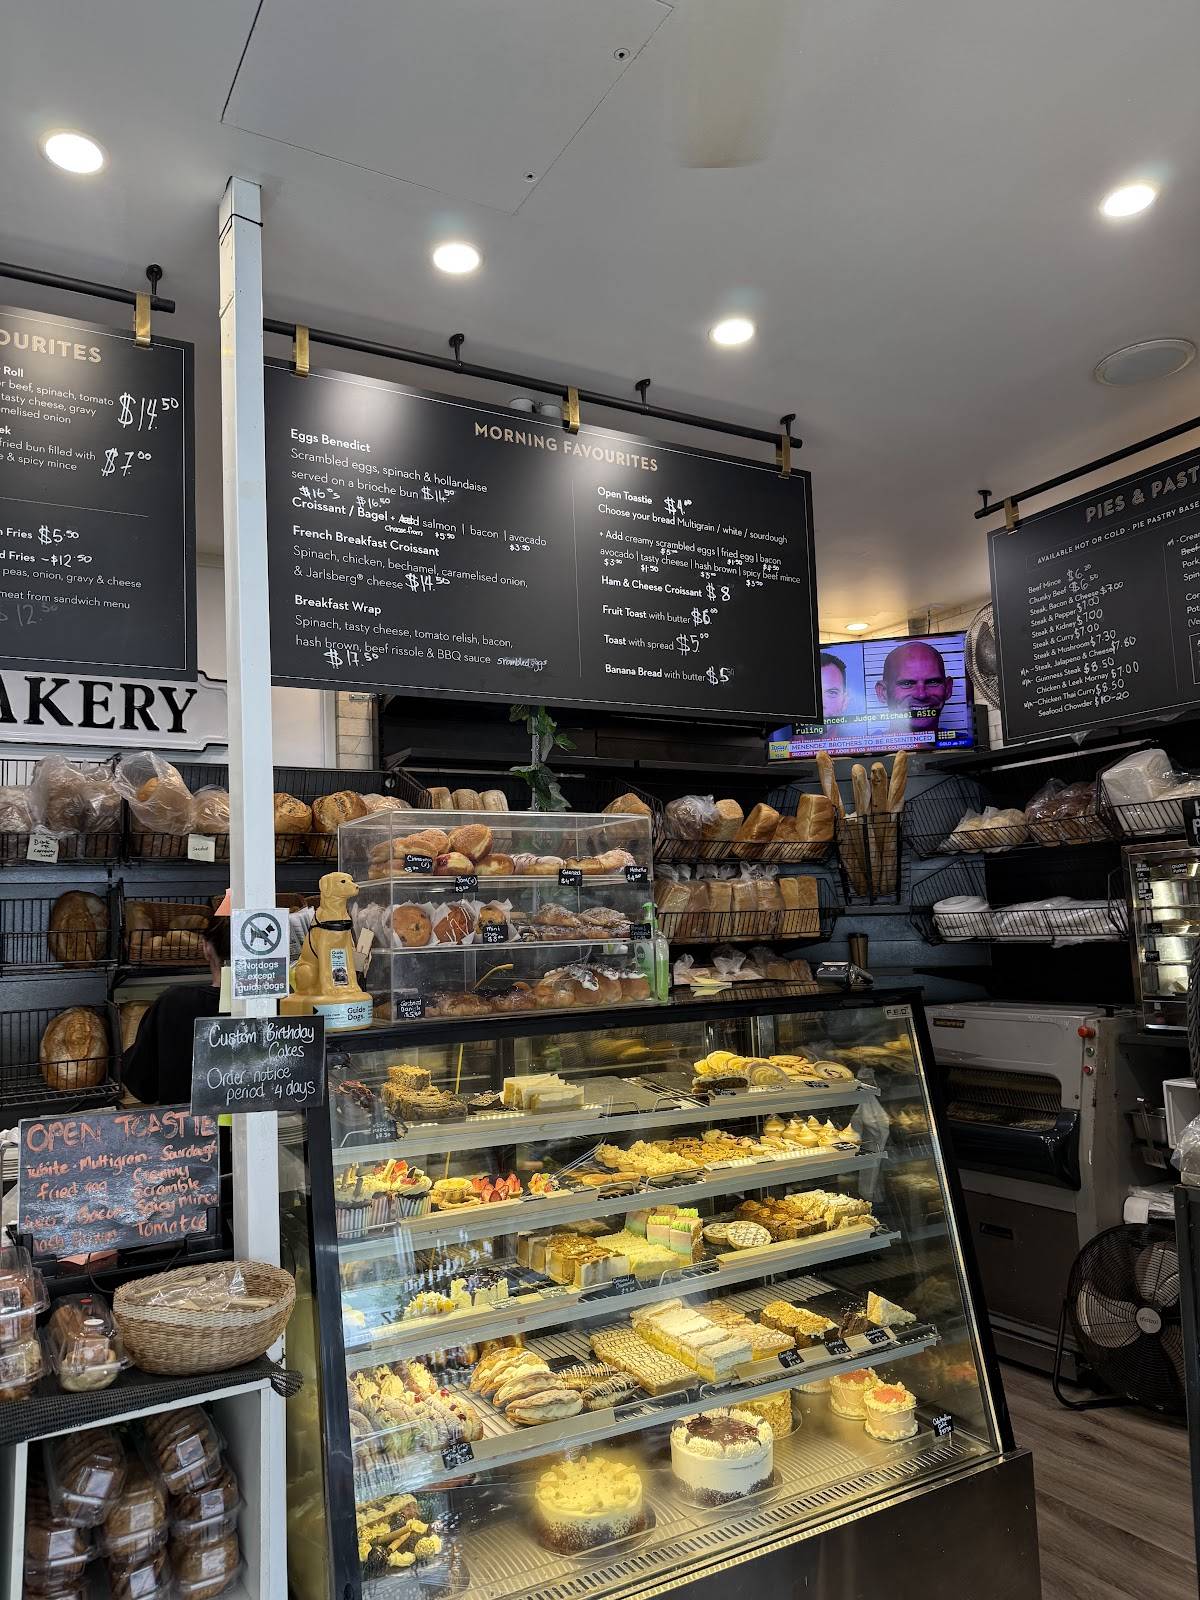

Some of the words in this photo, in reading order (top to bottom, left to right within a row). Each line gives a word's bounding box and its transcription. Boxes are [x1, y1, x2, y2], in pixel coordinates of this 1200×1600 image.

[4, 366, 23, 377] Roll
[9, 380, 33, 392] beef,
[36, 385, 77, 401] spinach,
[79, 393, 114, 406] tomato
[1, 394, 25, 406] tasty
[28, 396, 67, 412] cheese,
[69, 405, 96, 417] gravy
[44, 412, 71, 424] onion
[290, 428, 318, 444] Eggs
[321, 434, 371, 453] Benedict
[474, 422, 558, 452] MORNING
[563, 440, 658, 472] FAVOURITES
[25, 442, 46, 454] bun
[48, 445, 73, 457] filled
[75, 449, 96, 461] with
[18, 455, 44, 468] spicy
[47, 460, 77, 471] mince
[291, 448, 349, 468] Scrambled
[351, 462, 380, 474] eggs,
[382, 467, 421, 480] spinach
[434, 473, 488, 493] hollandaise
[291, 470, 328, 483] served
[331, 477, 345, 487] on
[357, 478, 397, 495] brioche
[399, 486, 419, 499] bun
[1085, 495, 1126, 523] PIES
[1151, 465, 1200, 498] PAST
[597, 486, 622, 499] Open
[623, 490, 653, 505] Toastie
[292, 497, 346, 515] Croissant
[357, 507, 388, 522] Bagel
[422, 519, 457, 533] salmon
[470, 524, 499, 539] bacon
[508, 533, 547, 546] avocado
[598, 504, 630, 517] Choose
[632, 512, 651, 521] your
[652, 512, 676, 525] bread
[677, 517, 715, 532] Multigrain
[722, 525, 742, 537] white
[750, 532, 788, 545] sourdough
[7, 528, 33, 539] Fries
[293, 525, 333, 541] French
[335, 531, 387, 549] Breakfast
[390, 540, 440, 557] Croissant
[1037, 547, 1073, 564] AVAILABLE
[1074, 540, 1090, 551] HOT
[1091, 535, 1103, 545] OR
[1104, 528, 1126, 540] COLD
[1132, 521, 1145, 530] PIE
[1147, 509, 1176, 525] PASTRY
[9, 551, 35, 563] Fries
[605, 530, 623, 541] Add
[625, 535, 654, 547] creamy
[656, 541, 695, 552] scrambled
[697, 546, 715, 557] eggs
[721, 547, 738, 559] fried
[760, 554, 781, 566] bacon
[293, 545, 340, 562] Spinach,
[342, 554, 385, 569] chicken,
[387, 558, 439, 575] bechamel,
[441, 569, 498, 583] caramelised
[500, 577, 528, 588] onion,
[600, 548, 635, 560] avocado
[641, 553, 659, 564] tasty
[661, 556, 689, 568] cheese
[695, 560, 712, 571] hash
[714, 563, 738, 574] brown
[780, 574, 801, 584] mince
[3, 568, 30, 578] peas,
[32, 570, 64, 581] onion,
[66, 574, 94, 585] gravy
[107, 577, 142, 588] cheese
[366, 576, 404, 589] cheese
[601, 575, 621, 587] Ham
[631, 580, 663, 592] Cheese
[664, 585, 702, 597] Croissant
[1028, 583, 1042, 594] Beef
[1043, 579, 1061, 588] Mince
[27, 591, 51, 601] from
[54, 595, 100, 606] sandwich
[103, 601, 130, 609] menu
[294, 594, 349, 611] Breakfast
[352, 601, 382, 616] Wrap
[1029, 593, 1052, 605] Chunky
[1052, 586, 1067, 597] Beef
[602, 605, 623, 616] Fruit
[625, 607, 647, 619] Toast
[648, 612, 666, 621] with
[666, 612, 691, 624] butter
[295, 615, 342, 631] Spinach,
[345, 622, 370, 635] tasty
[373, 623, 412, 638] cheese,
[414, 629, 450, 641] tomato
[452, 632, 480, 644] relish,
[482, 635, 513, 648] bacon,
[295, 634, 321, 648] hash
[325, 637, 362, 653] brown,
[364, 641, 389, 654] beef
[391, 646, 424, 658] rissole
[437, 649, 461, 662] BBQ
[464, 654, 491, 664] sauce
[603, 634, 626, 645] Toast
[627, 638, 645, 648] with
[647, 641, 674, 651] spread
[1032, 639, 1049, 650] Steak
[1056, 633, 1075, 643] Curry
[1033, 650, 1050, 661] Steak
[1057, 641, 1090, 654] Mushroom
[605, 663, 636, 676] Banana
[637, 666, 662, 678] Bread
[664, 670, 680, 679] with
[682, 671, 706, 682] butter
[1035, 672, 1063, 683] Guinness
[1063, 666, 1081, 676] Steak
[1036, 684, 1061, 694] Chicken
[1068, 677, 1083, 687] Leek
[1084, 672, 1109, 683] Mornay
[1037, 696, 1062, 706] Chicken
[1063, 691, 1077, 699] Thai
[1077, 687, 1096, 697] Curry
[880, 711, 913, 720] Michael
[1038, 705, 1064, 717] Seafood
[1064, 700, 1093, 711] Chowder
[795, 727, 824, 735] ruling
[828, 741, 863, 749] BROTHERS
[244, 961, 257, 969] No
[257, 960, 279, 971] dogs
[247, 972, 275, 981] except
[238, 983, 262, 993] guide
[263, 982, 285, 992] dogs
[347, 1006, 366, 1014] Guide
[208, 1024, 257, 1048] Custom
[266, 1022, 315, 1043] Birthday
[268, 1041, 305, 1059] Cakes
[207, 1067, 247, 1089] Order
[253, 1066, 292, 1083] notice
[226, 1083, 264, 1106] period
[274, 1084, 282, 1099] 4
[286, 1080, 316, 1103] days
[26, 1121, 101, 1152] OPEN
